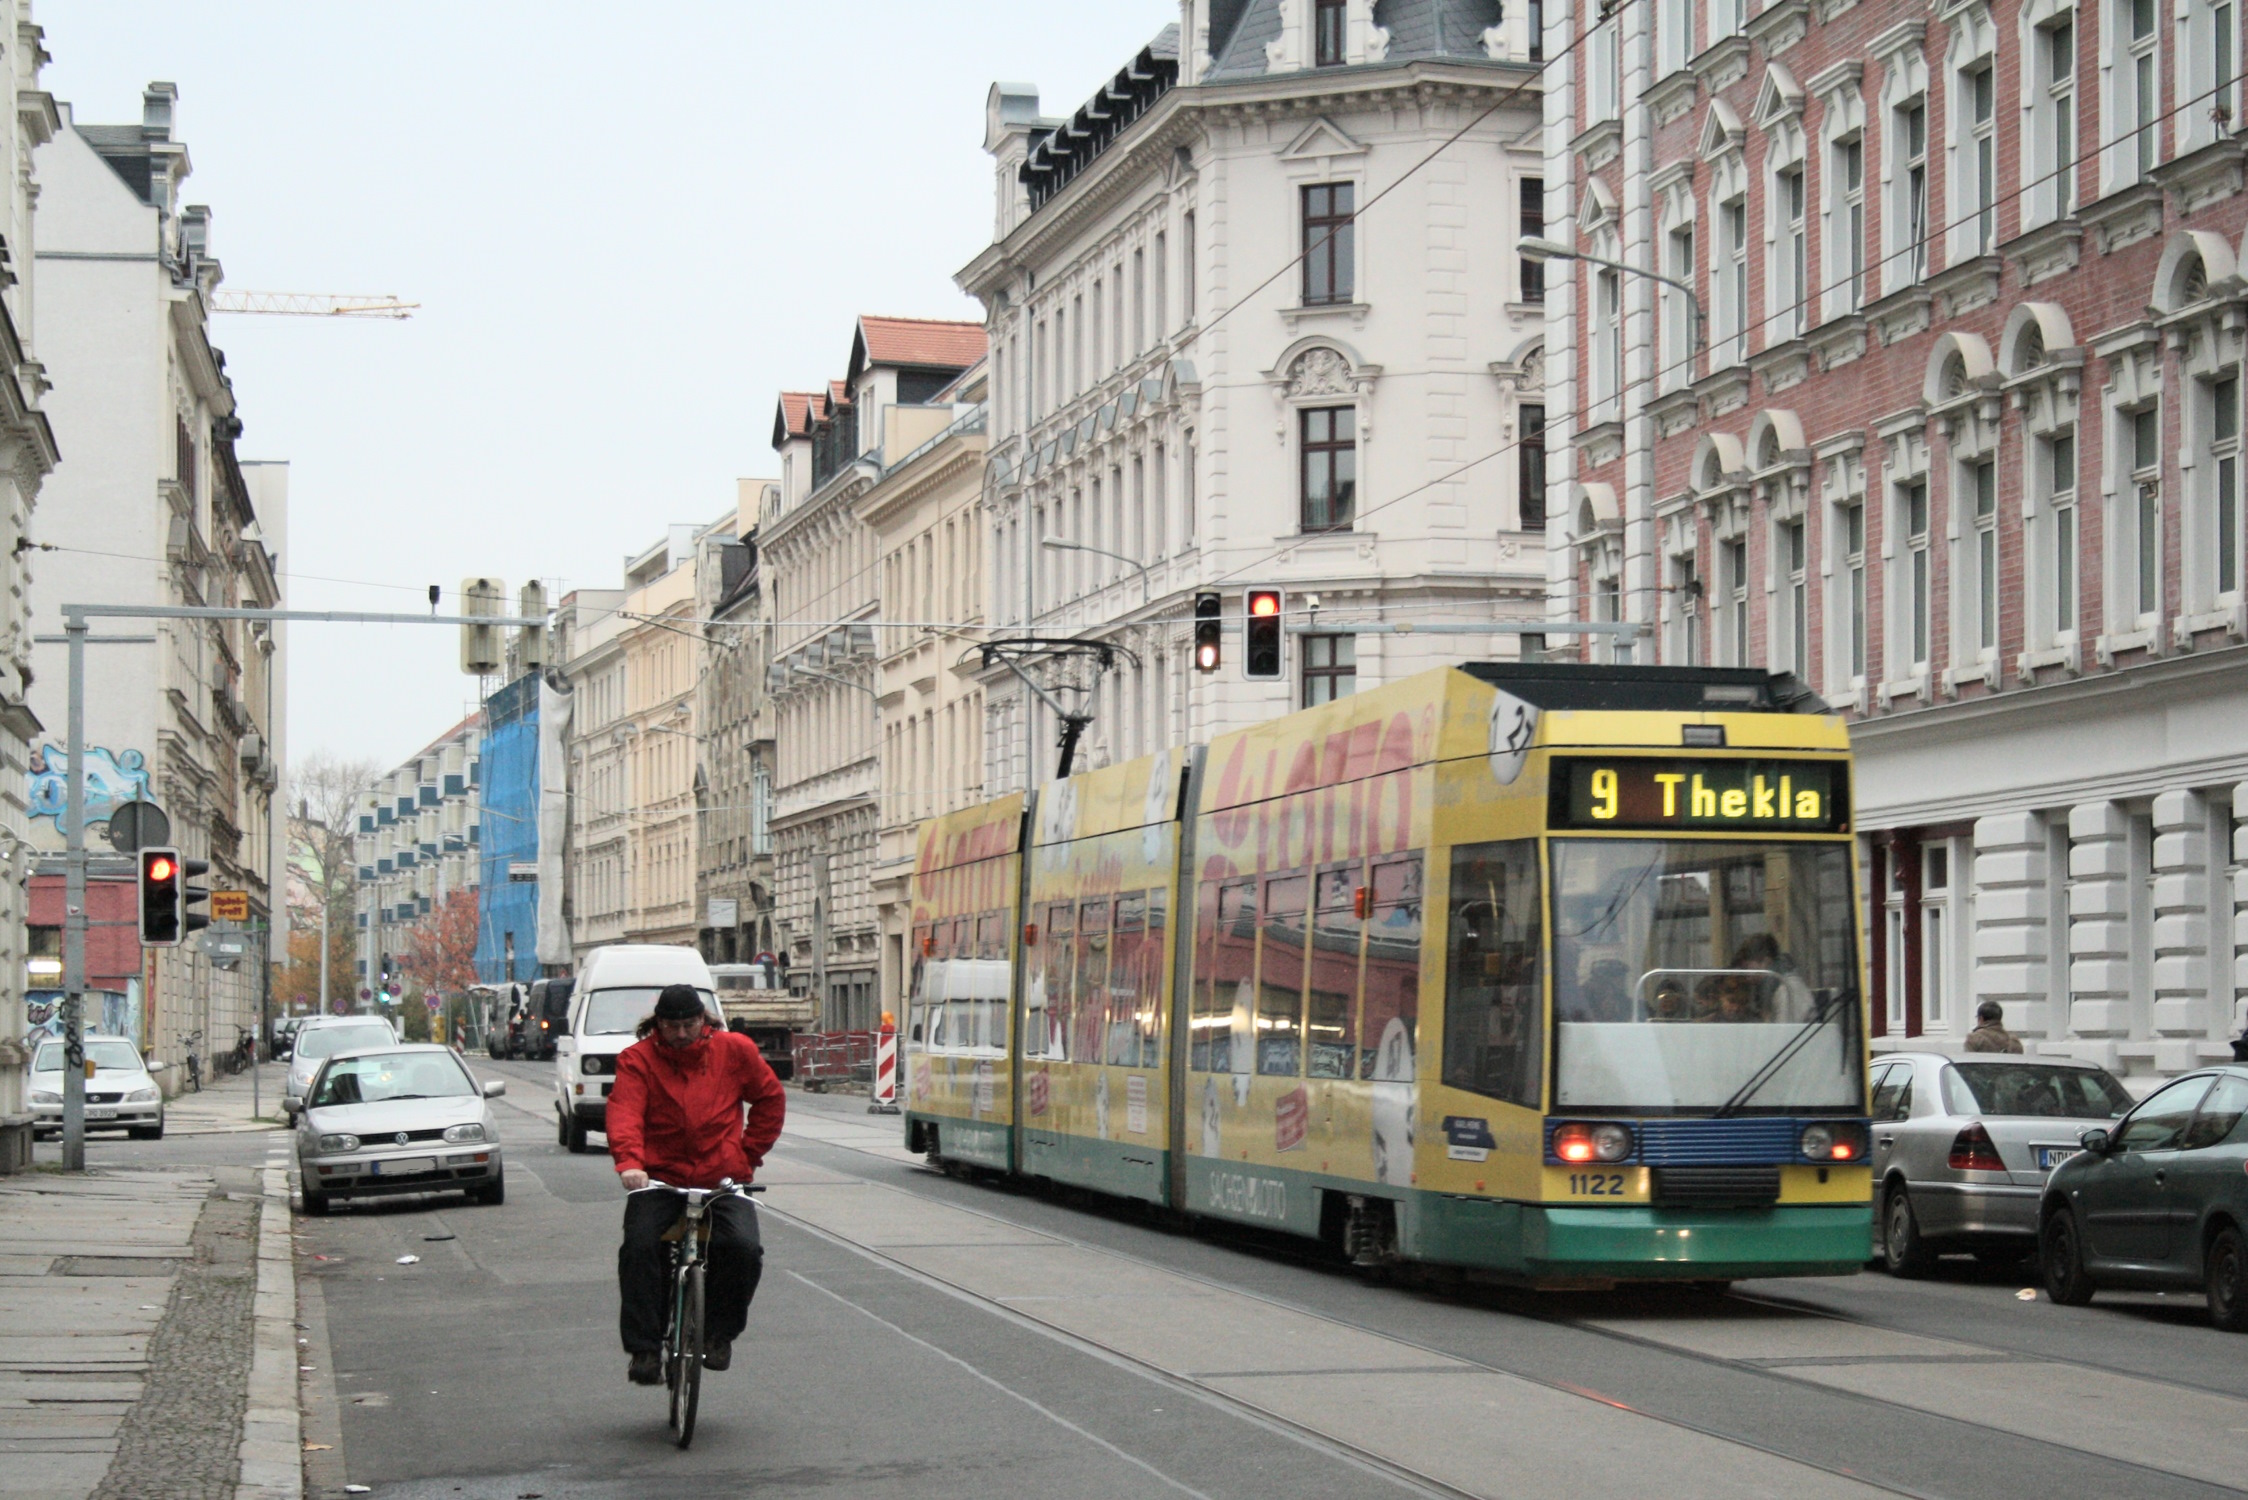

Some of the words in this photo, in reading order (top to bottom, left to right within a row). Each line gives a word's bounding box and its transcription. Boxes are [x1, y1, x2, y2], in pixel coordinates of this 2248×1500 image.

[1591, 769, 1618, 819] 9
[1654, 773, 1820, 819] Thekla
[1570, 1174, 1624, 1195] 1122
